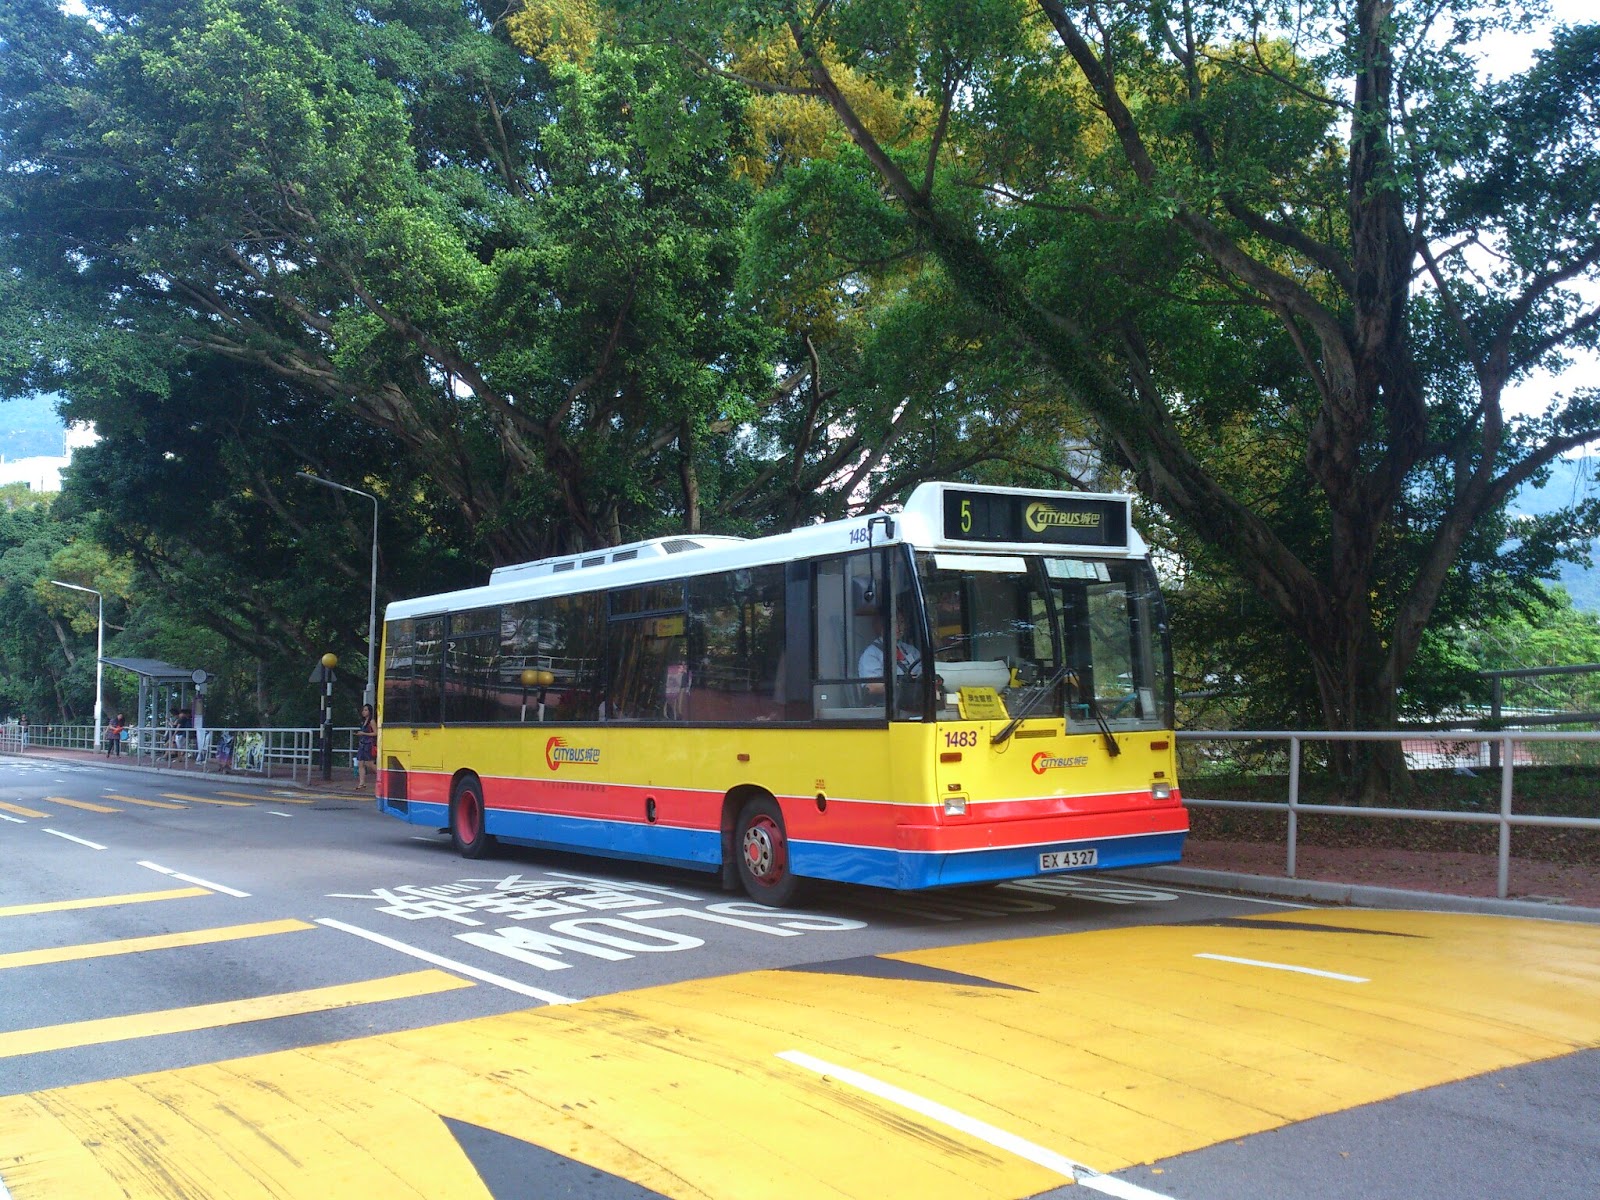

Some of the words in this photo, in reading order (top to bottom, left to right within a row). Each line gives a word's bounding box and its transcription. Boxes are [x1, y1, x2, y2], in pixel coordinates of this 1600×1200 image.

[960, 499, 972, 533] 5
[1036, 511, 1080, 525] CITYBUS
[944, 730, 978, 748] 1483
[553, 747, 585, 761] CITYBUS
[1040, 757, 1074, 768] CITYBUS
[1041, 854, 1060, 869] EX
[1063, 850, 1096, 867] 4327
[451, 902, 869, 971] SLOW
